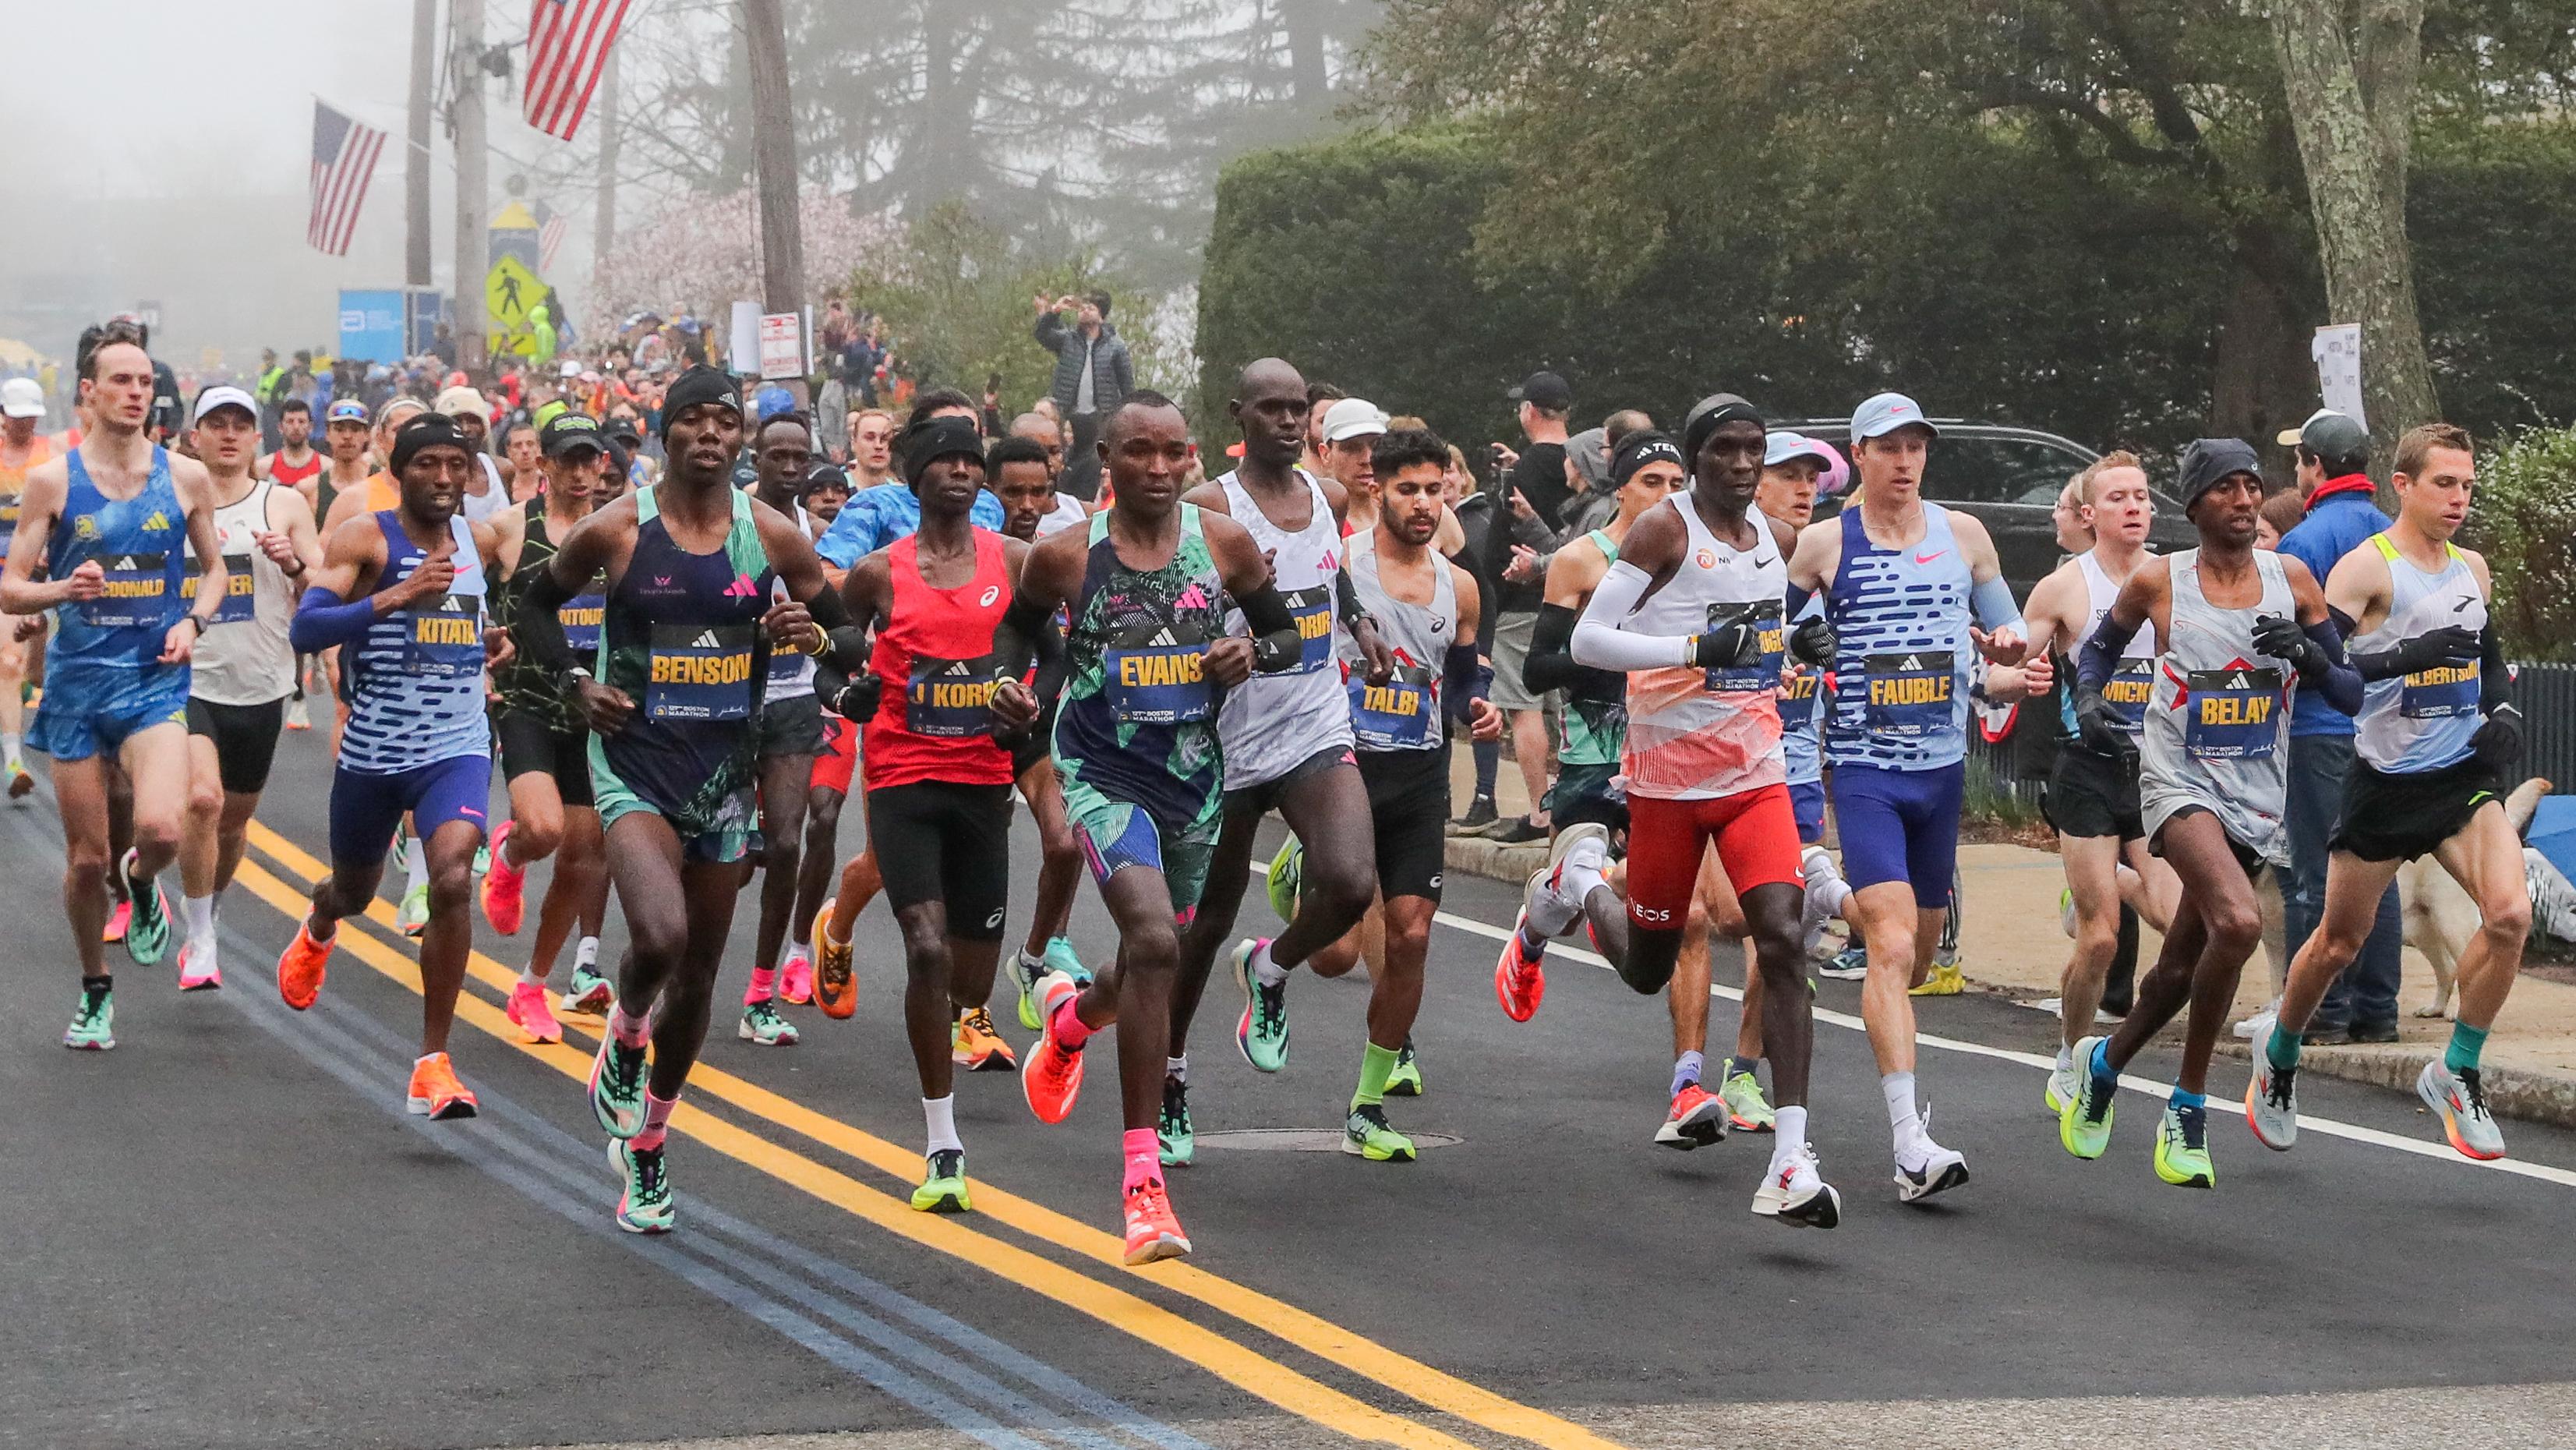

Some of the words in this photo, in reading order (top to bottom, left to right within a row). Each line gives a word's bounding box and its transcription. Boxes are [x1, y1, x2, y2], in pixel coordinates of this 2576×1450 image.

[415, 617, 476, 645] KITATA
[651, 652, 751, 685] BENSON
[1120, 652, 1203, 686] EVANS
[910, 683, 925, 705] J
[1363, 684, 1419, 716] TALBI
[1871, 676, 1950, 706] FAUBLE
[2201, 696, 2271, 725] BELAY
